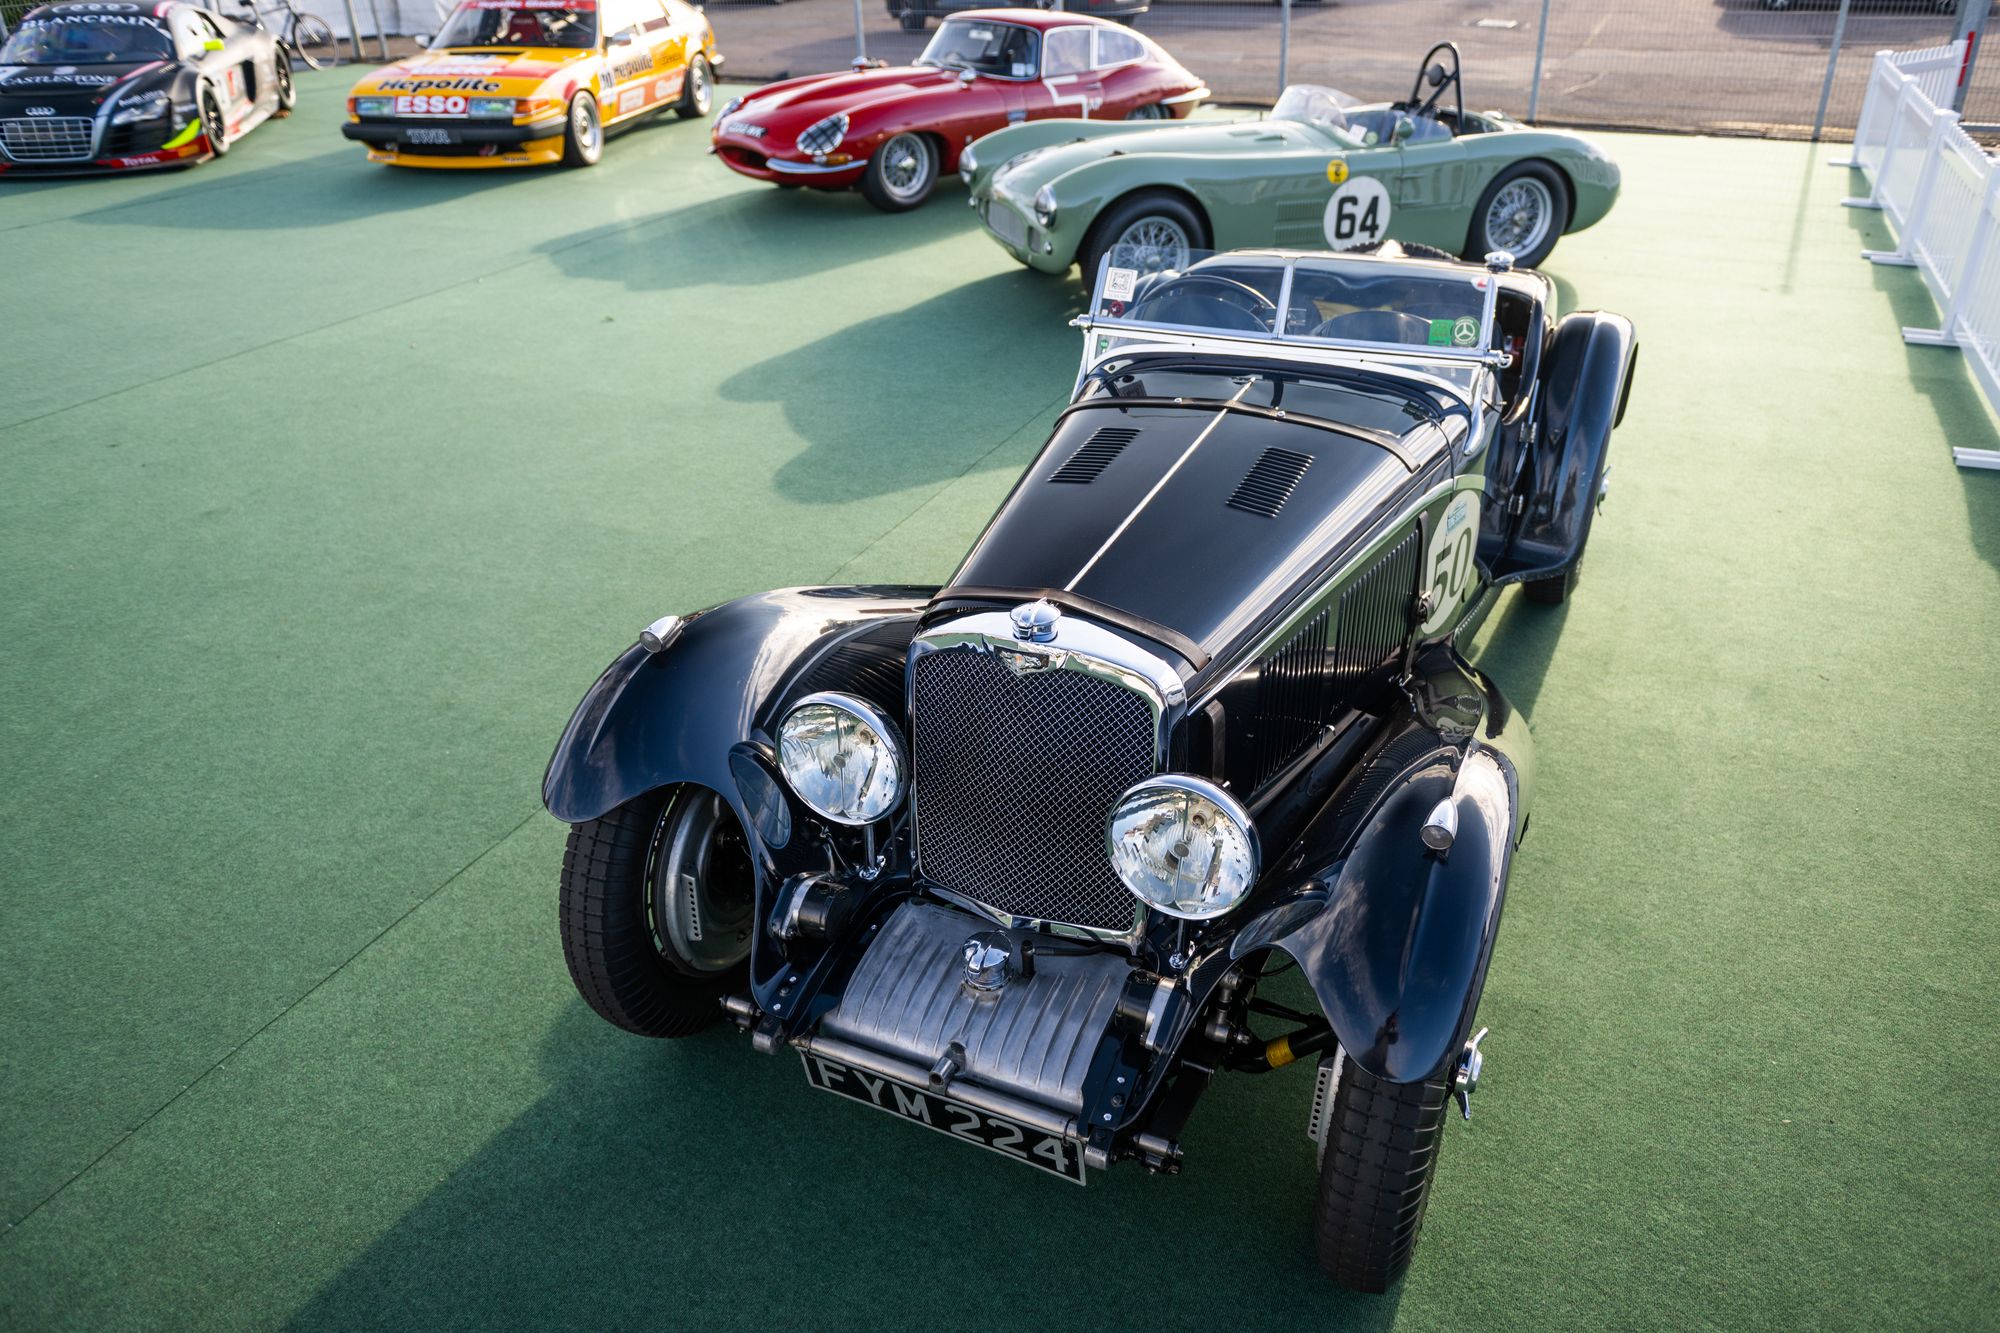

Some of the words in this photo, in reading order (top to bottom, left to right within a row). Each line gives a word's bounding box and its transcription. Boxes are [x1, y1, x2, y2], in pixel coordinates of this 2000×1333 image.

[20, 15, 161, 30] BLANCPAIN
[0, 75, 118, 87] CASTLESTONE
[377, 77, 500, 94] Hepolite
[396, 96, 466, 113] ESSO
[406, 128, 451, 144] TWR
[1334, 195, 1380, 240] 64
[1431, 527, 1472, 613] 50
[815, 1057, 932, 1125] FYM
[944, 1103, 1070, 1173] 224
